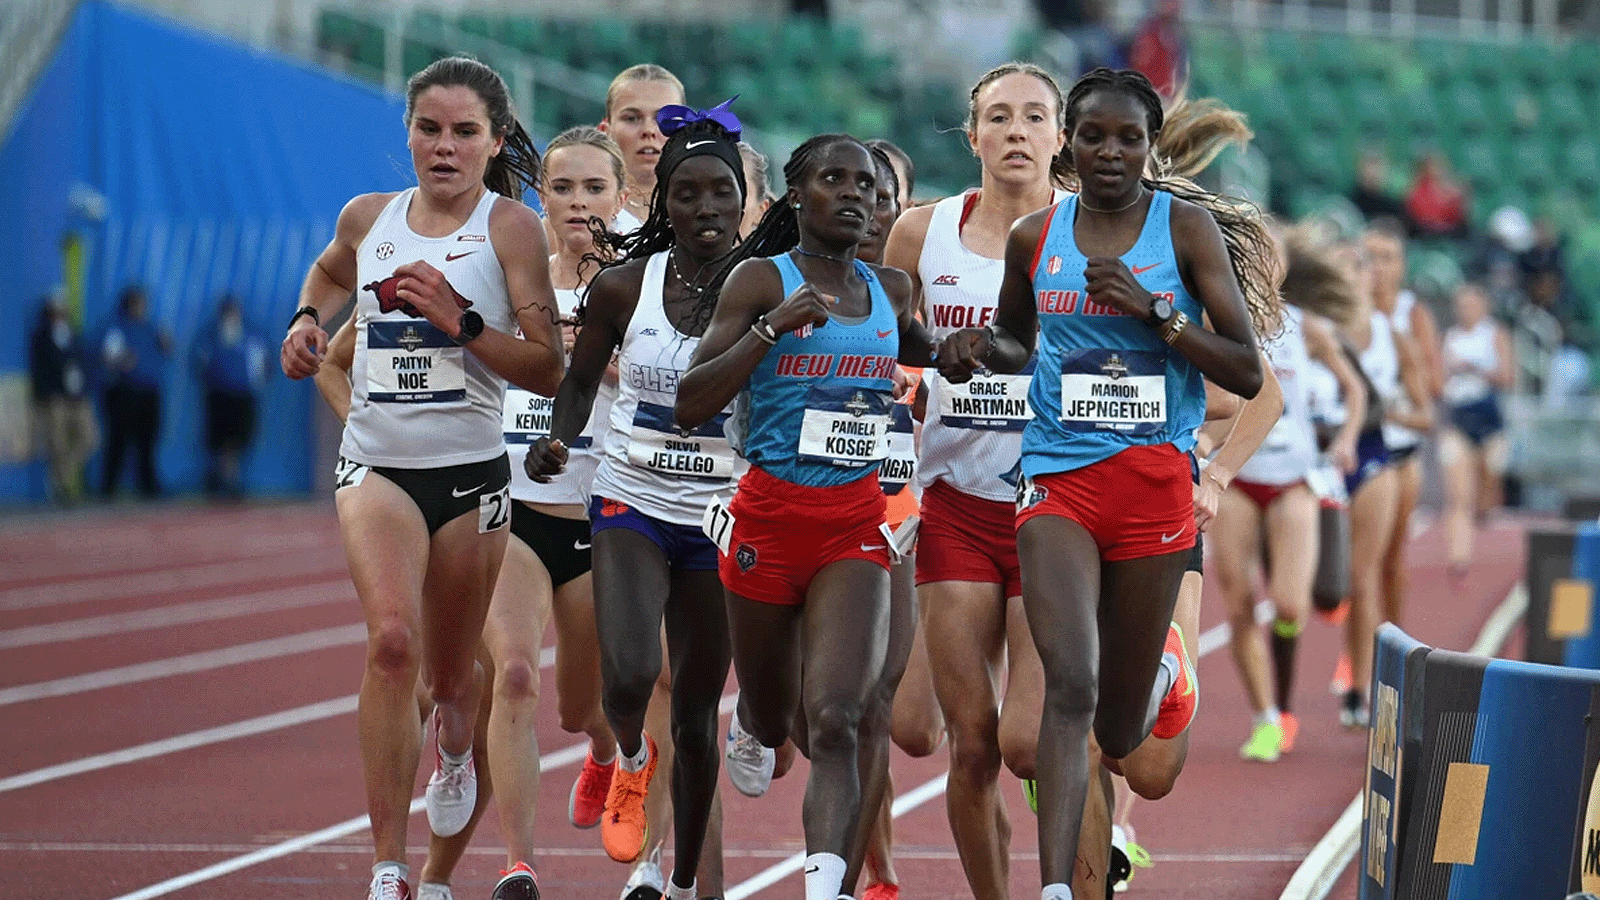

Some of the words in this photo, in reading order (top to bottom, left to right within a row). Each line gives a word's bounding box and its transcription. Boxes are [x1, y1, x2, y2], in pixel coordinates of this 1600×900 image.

[932, 275, 960, 285] ACC
[639, 328, 659, 336] ACC
[392, 356, 432, 370] PAITYN
[776, 354, 834, 377] NEW
[398, 372, 428, 390] NOE
[629, 363, 685, 395] CLE
[969, 381, 1007, 396] GRACE
[1091, 383, 1139, 398] MARION
[952, 398, 1026, 417] HARTMAN
[1067, 401, 1160, 420] JEPNGETICH
[832, 420, 875, 436] PAMELA
[664, 440, 701, 453] SILVIA
[648, 452, 714, 473] JELELGO
[710, 503, 730, 545] 17
